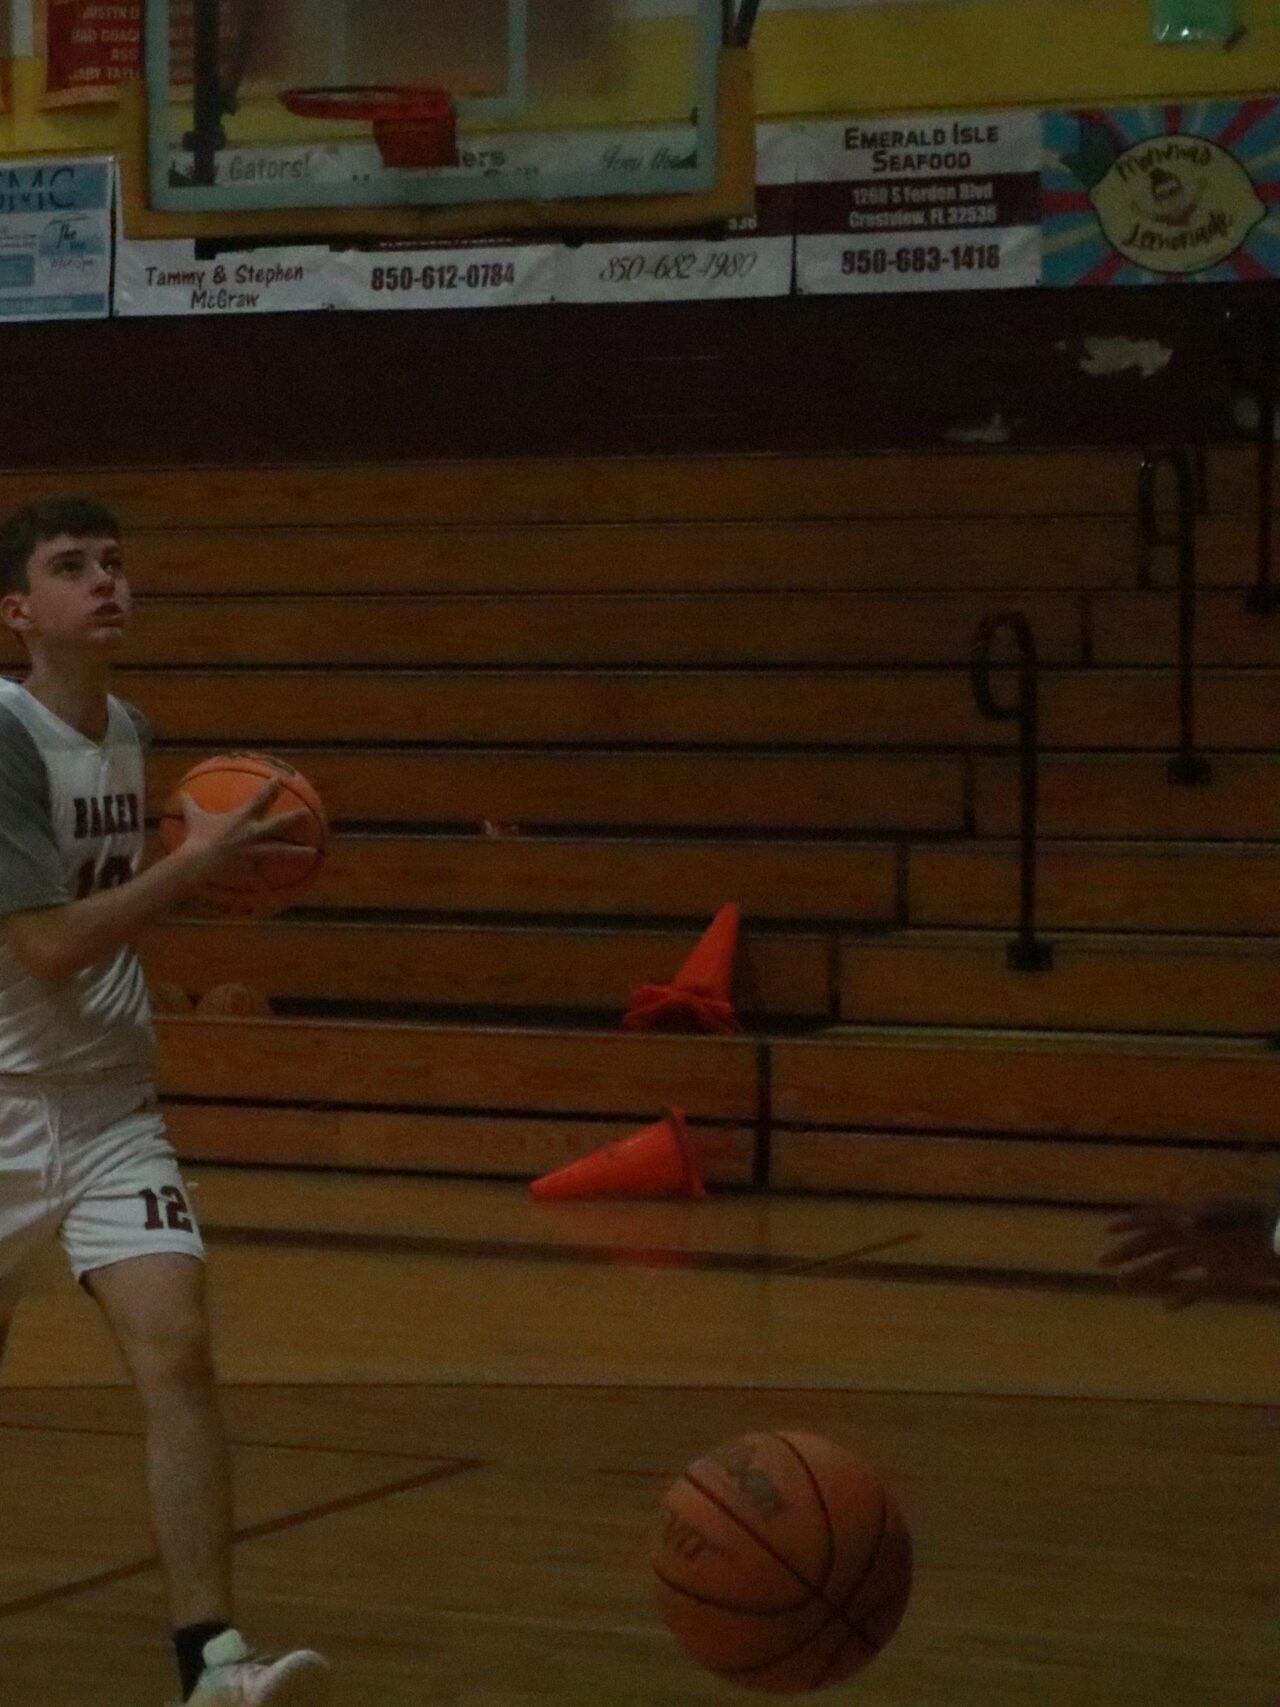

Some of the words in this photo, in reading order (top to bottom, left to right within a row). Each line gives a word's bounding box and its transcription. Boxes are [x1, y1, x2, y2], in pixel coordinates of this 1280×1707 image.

[843, 126, 946, 150] EMERALD
[953, 122, 1000, 145] ISLE
[872, 150, 972, 173] SEAFOOD
[599, 251, 758, 283] 850-682-1980
[840, 244, 1001, 275] 850-683-1418
[144, 265, 206, 290] Tammy
[213, 264, 227, 285] &
[235, 262, 304, 286] Stephen
[370, 261, 516, 292] 850-612-0784
[190, 289, 260, 310] McGraw
[73, 793, 140, 840] BAKER
[138, 1185, 194, 1234] 12
